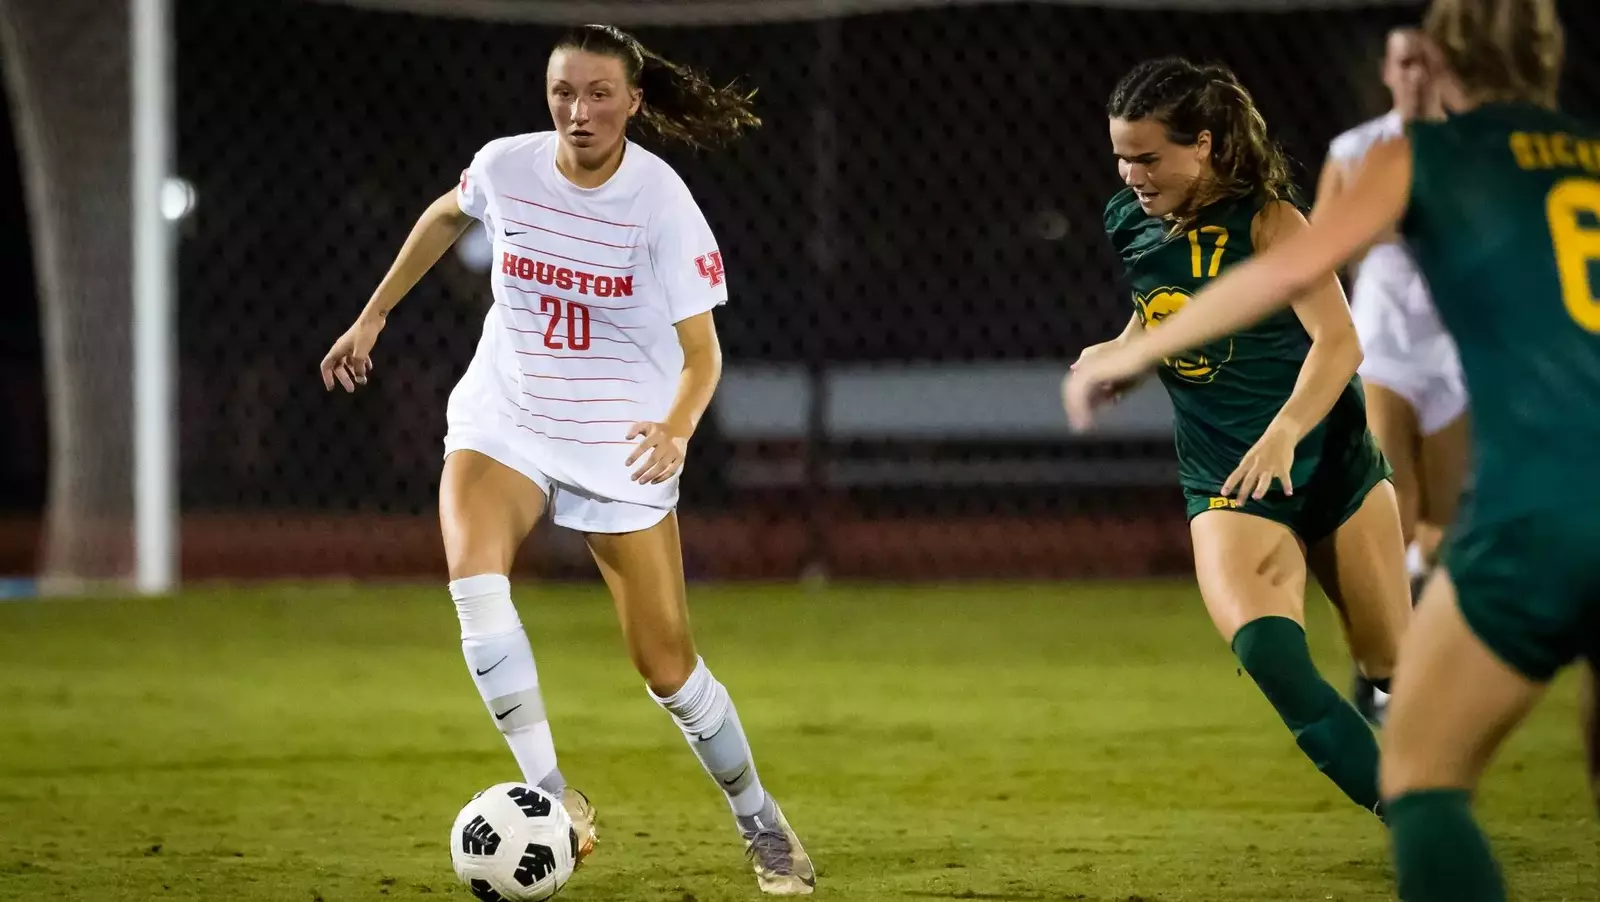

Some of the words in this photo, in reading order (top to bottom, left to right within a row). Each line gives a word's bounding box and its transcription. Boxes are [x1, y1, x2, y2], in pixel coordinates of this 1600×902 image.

[501, 251, 634, 298] HOUSTON
[1188, 225, 1229, 278] 17
[540, 296, 591, 351] 20
